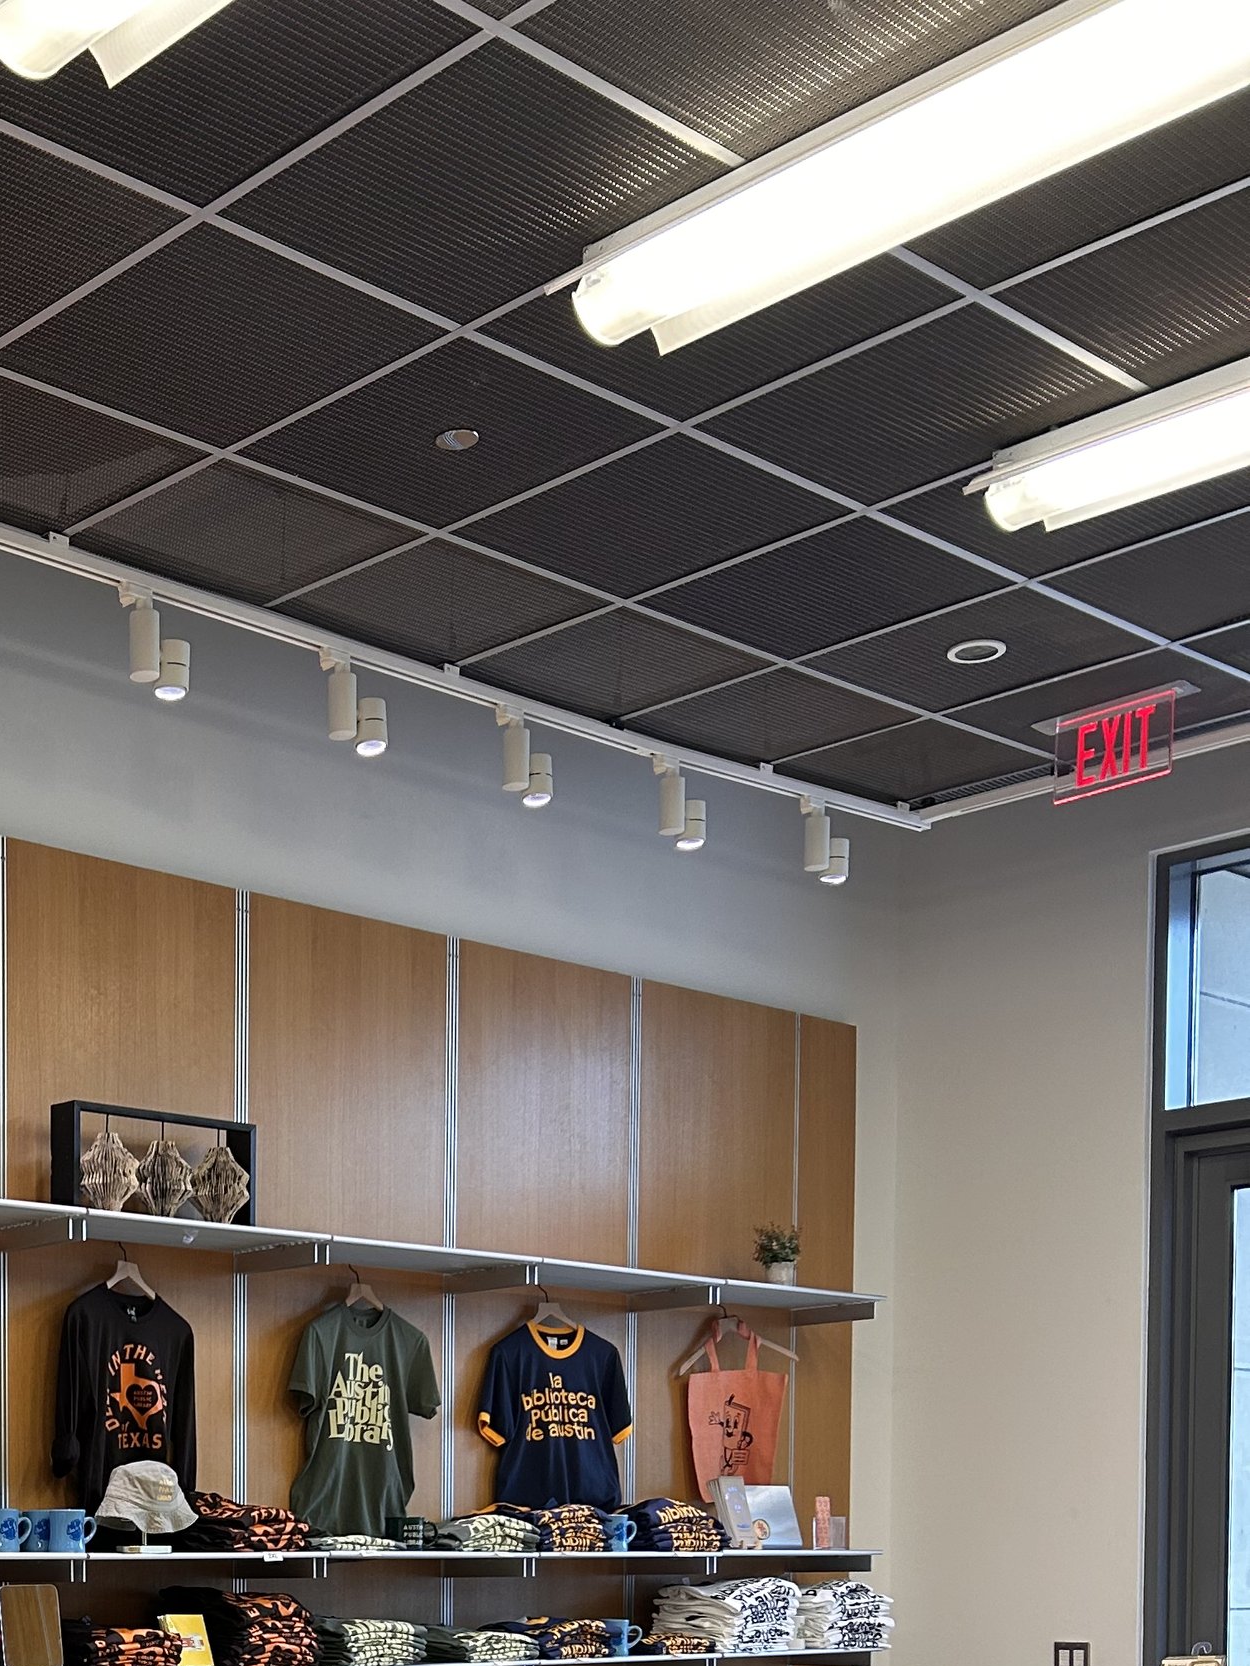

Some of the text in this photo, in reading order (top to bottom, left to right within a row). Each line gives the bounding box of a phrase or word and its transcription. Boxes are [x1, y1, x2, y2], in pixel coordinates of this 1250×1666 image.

[1076, 704, 1156, 788] EXIT
[108, 1344, 155, 1376] IN THE
[345, 1351, 383, 1382] The
[328, 1370, 391, 1408] Austin
[549, 1372, 562, 1389] la
[328, 1410, 394, 1451] Lbrary
[526, 1422, 595, 1441] de austin
[531, 1405, 588, 1427] pública
[117, 1432, 162, 1449] TEXAS
